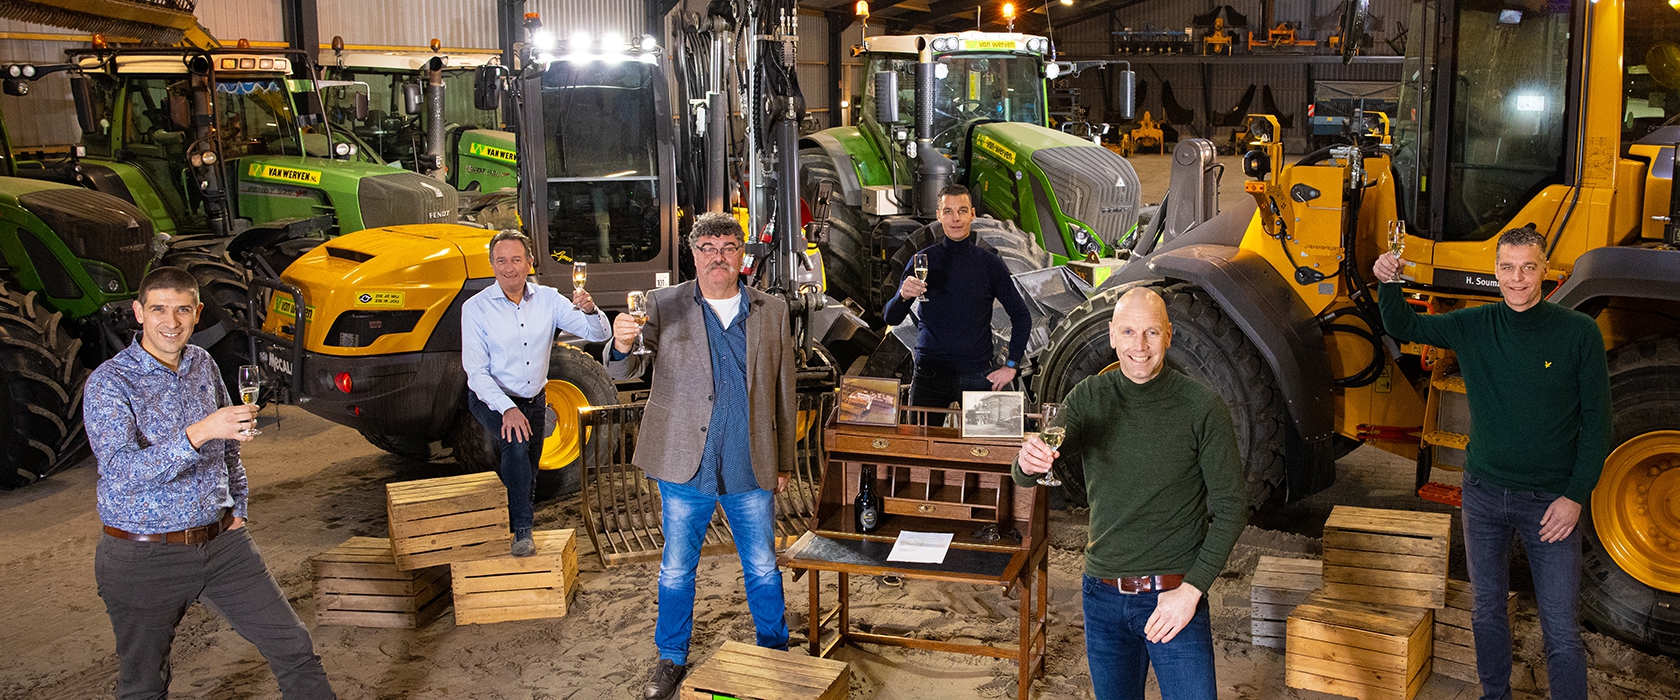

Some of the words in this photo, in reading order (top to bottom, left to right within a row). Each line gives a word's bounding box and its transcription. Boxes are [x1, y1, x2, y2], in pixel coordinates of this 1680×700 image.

[487, 148, 499, 157] VAN
[268, 167, 282, 177] VAN
[428, 209, 451, 219] FENDT
[1466, 276, 1474, 285] H.
